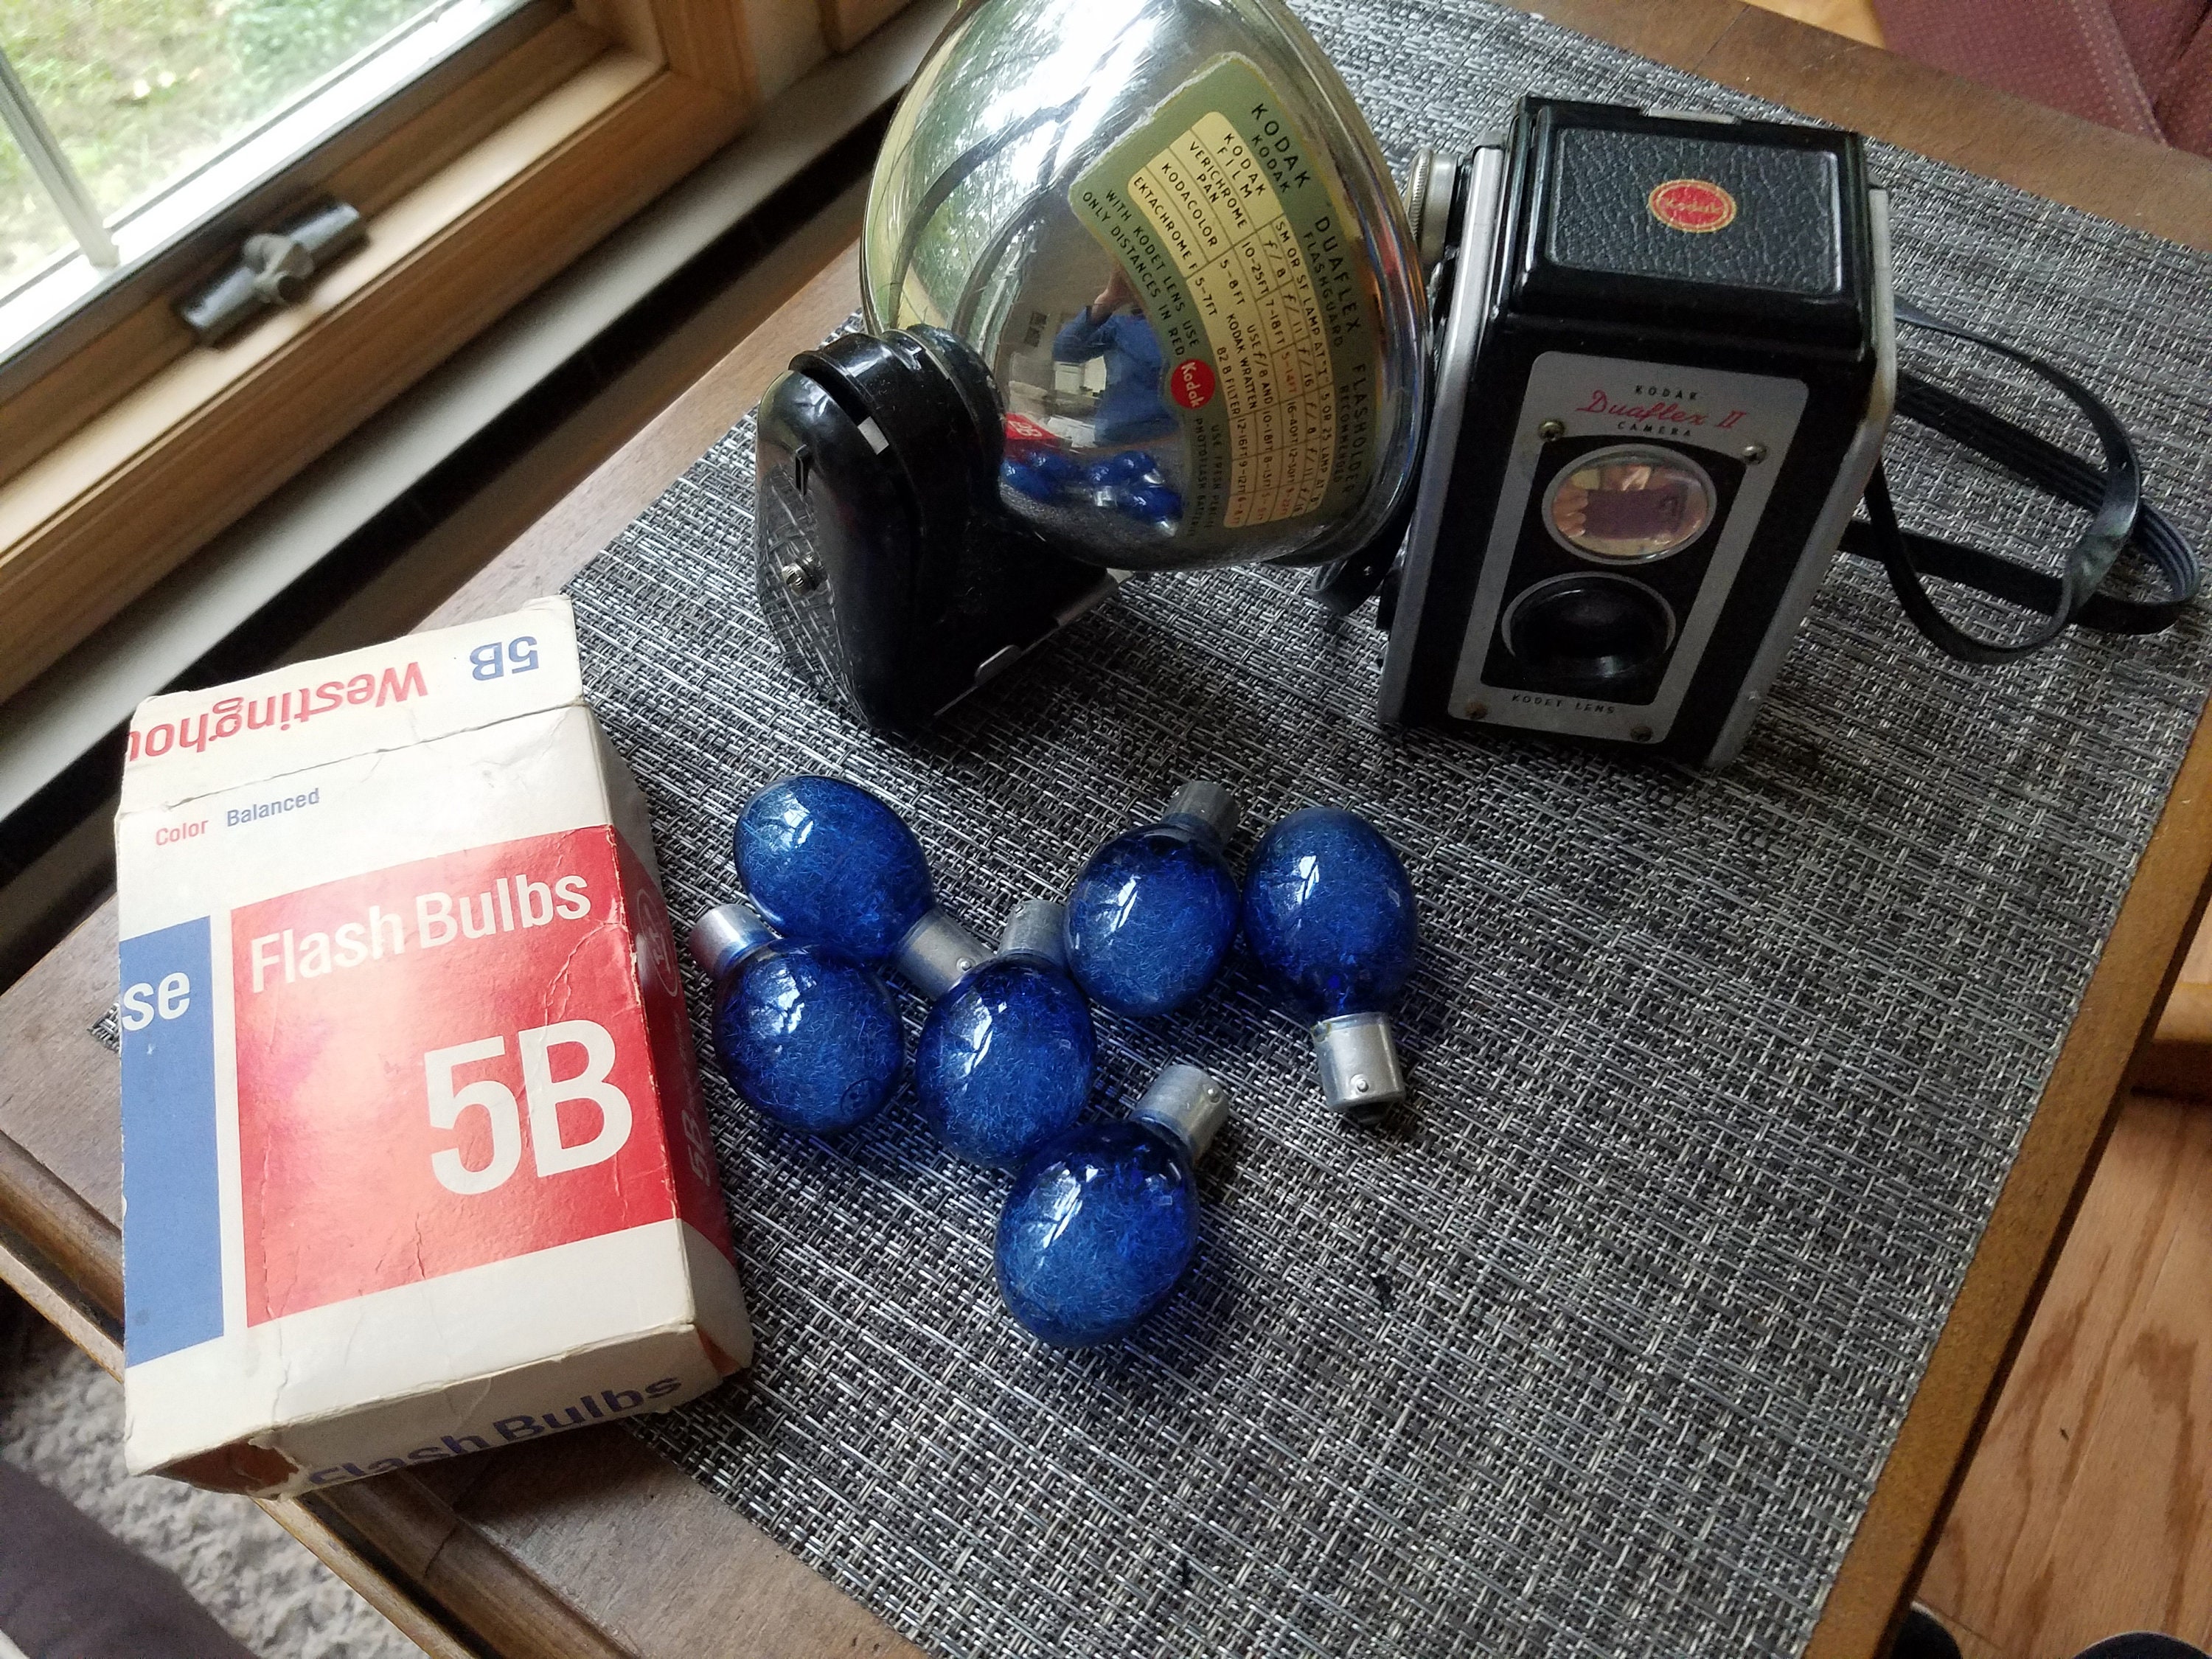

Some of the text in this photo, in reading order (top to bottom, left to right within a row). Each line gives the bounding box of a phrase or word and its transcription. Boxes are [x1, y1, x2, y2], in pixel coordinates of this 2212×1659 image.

[1189, 141, 1248, 229] VERICHROME
[1196, 173, 1220, 204] PAN
[1217, 147, 1253, 198] FILM
[1223, 133, 1267, 196] KODAK
[1133, 176, 1192, 260] EKTACHROME
[1161, 162, 1217, 247] KODACOLOR
[1106, 189, 1200, 347] WITH KODET LENS USE
[1242, 241, 1269, 294] 10-25FT
[1251, 134, 1290, 193] KODAK
[1304, 232, 1343, 347] FLASHGUARD
[1082, 192, 1186, 356] ONLY DISTANCES IN RED
[1195, 277, 1217, 316] 5-7FT
[1251, 102, 1368, 493] KODAK DUAFLEX FLASHOLDER
[1276, 221, 1290, 243] SM
[1287, 248, 1301, 268] OR
[1296, 274, 1309, 291] SF
[1303, 297, 1321, 335] LAMP
[1314, 341, 1326, 358] AT
[1266, 299, 1285, 344] 7-18FT
[1181, 361, 1205, 408] Kodak
[1217, 347, 1241, 414] 82 B FILTER
[1226, 313, 1258, 410] KODAK WRATTEN
[1247, 324, 1262, 348] USE
[1262, 383, 1273, 405] AND
[1322, 406, 1332, 421] OR
[1576, 389, 1747, 429] Duaflex II
[1635, 385, 1699, 400] KODAK
[1617, 421, 1691, 437] CAMERA
[1316, 479, 1324, 489] AT
[1320, 447, 1329, 473] LAMP
[468, 635, 540, 682] 5B
[1512, 694, 1615, 714] KODET LENS
[156, 787, 321, 846] Color Balanced
[251, 874, 591, 994] Flash Bulbs
[122, 972, 190, 1031] se
[423, 1018, 633, 1195] 5B
[681, 1110, 712, 1188] 5B
[493, 1376, 684, 1441] Bulbs
